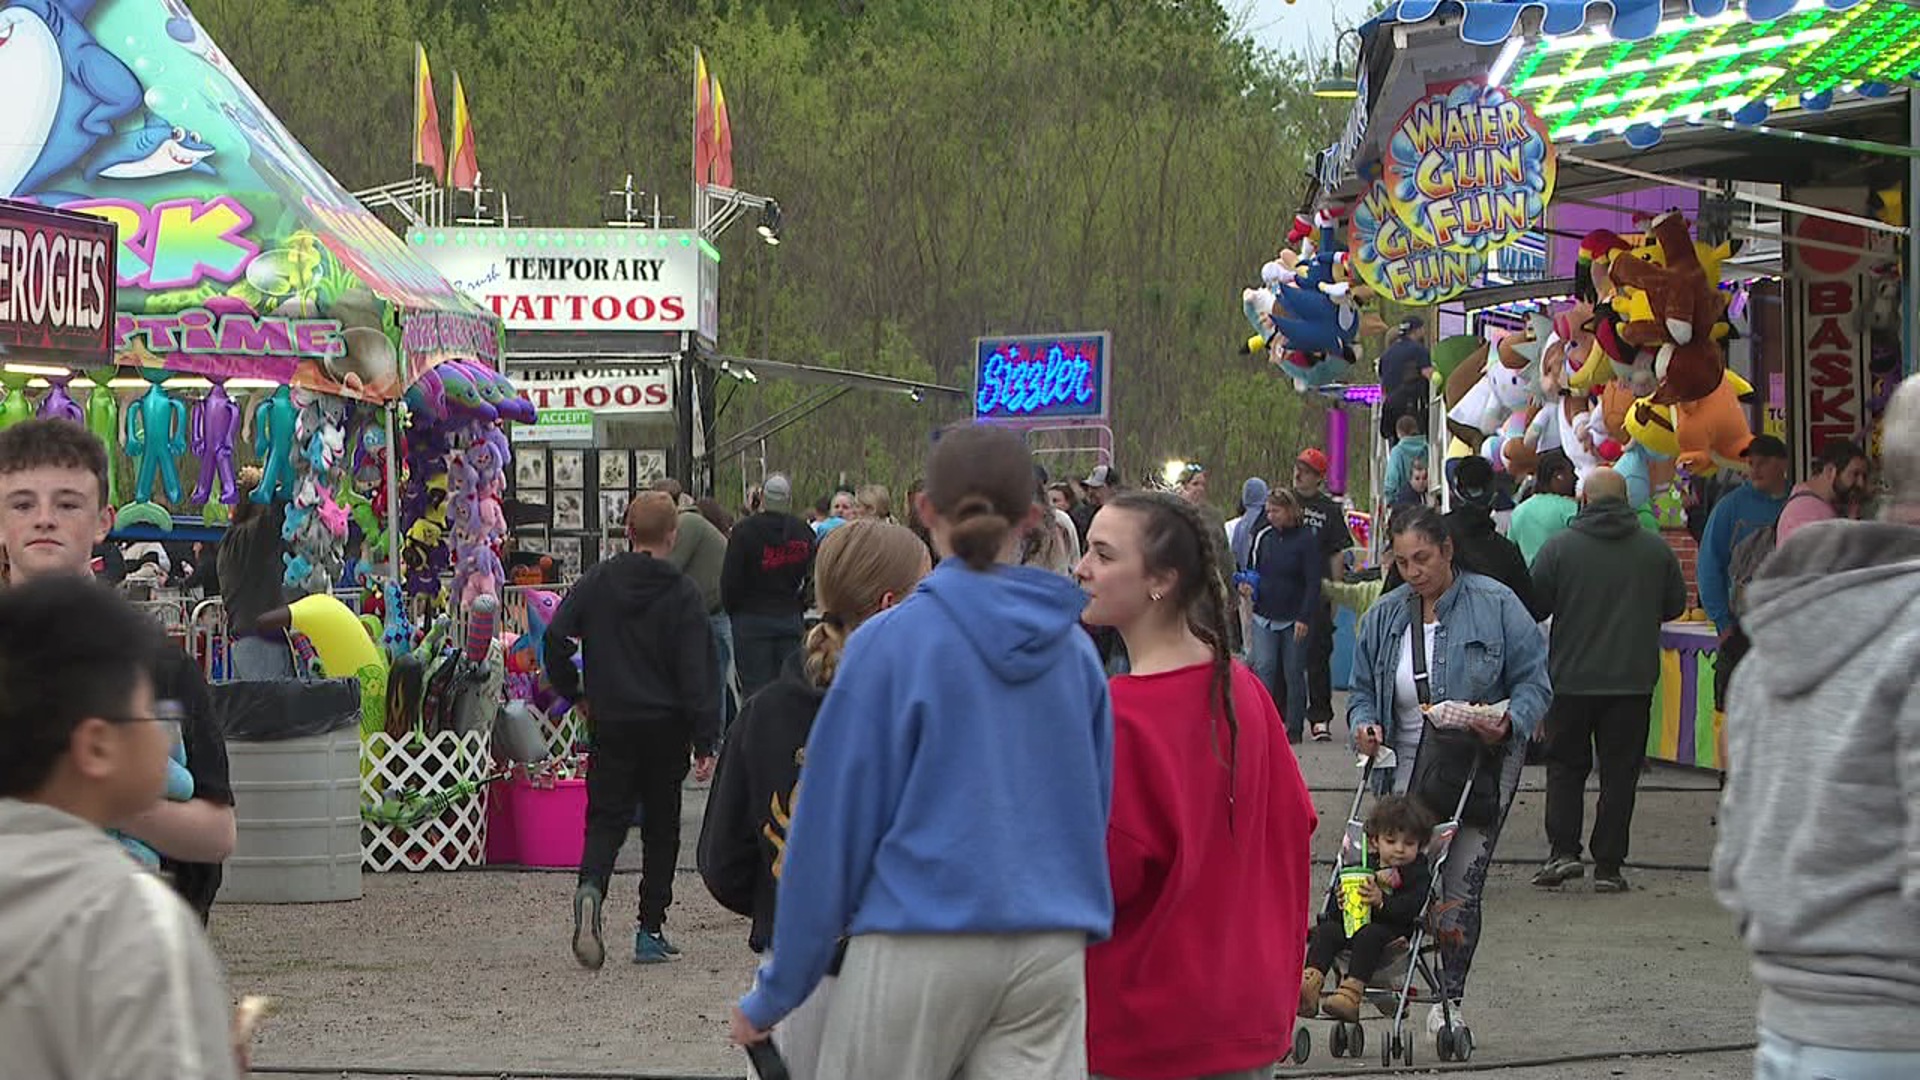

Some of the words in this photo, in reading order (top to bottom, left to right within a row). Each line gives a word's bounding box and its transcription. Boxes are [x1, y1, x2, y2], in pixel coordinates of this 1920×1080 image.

[1402, 101, 1531, 153] WATER
[1415, 147, 1524, 199] GUN
[1427, 192, 1526, 246] FUN
[506, 257, 665, 281] TEMPORARY
[1386, 252, 1469, 300] FUN
[485, 295, 685, 321] TATTOOS
[977, 345, 1093, 413] Sizzler
[541, 412, 588, 424] ACCEPT
